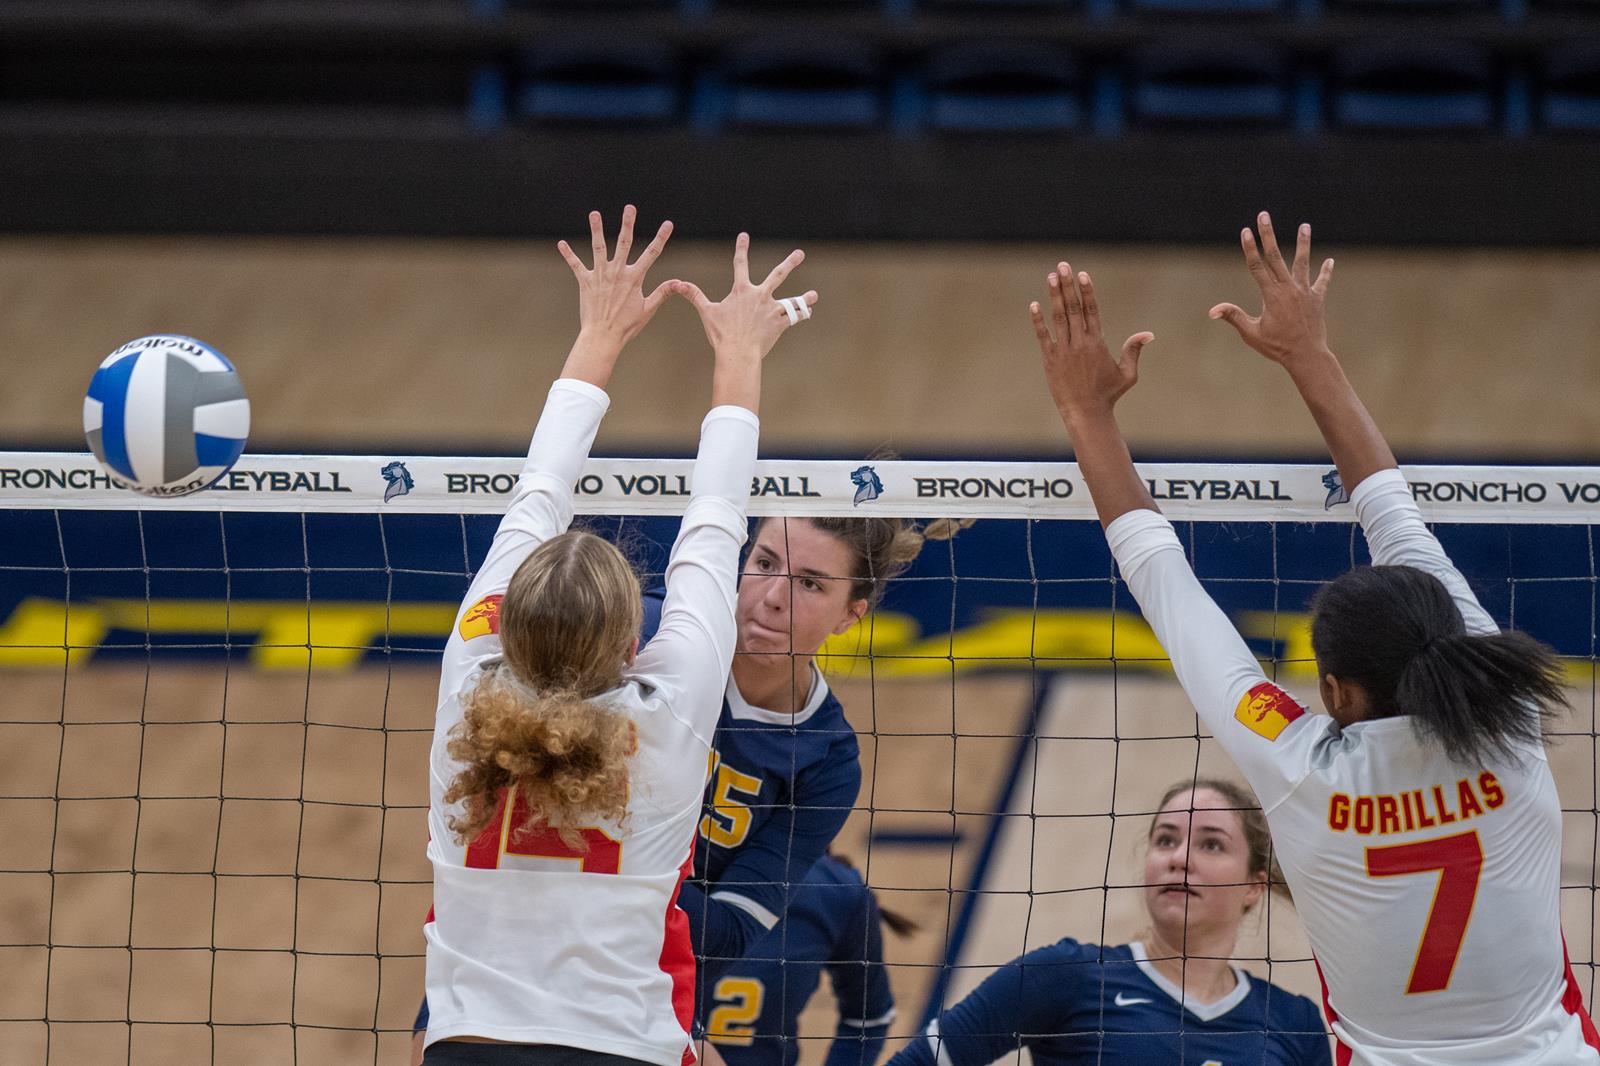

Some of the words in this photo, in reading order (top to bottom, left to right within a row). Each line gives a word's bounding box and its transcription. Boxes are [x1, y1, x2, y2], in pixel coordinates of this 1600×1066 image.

[0, 468, 128, 490] RONCH
[211, 470, 353, 493] EYBALL
[443, 473, 604, 495] BROO
[612, 474, 822, 497] VOLLBALL
[912, 477, 1074, 499] BRONCHO
[1144, 478, 1294, 501] LEYBALL
[1407, 480, 1547, 503] RONCHO
[1327, 770, 1506, 836] GORILLAS
[1363, 829, 1485, 996] 7
